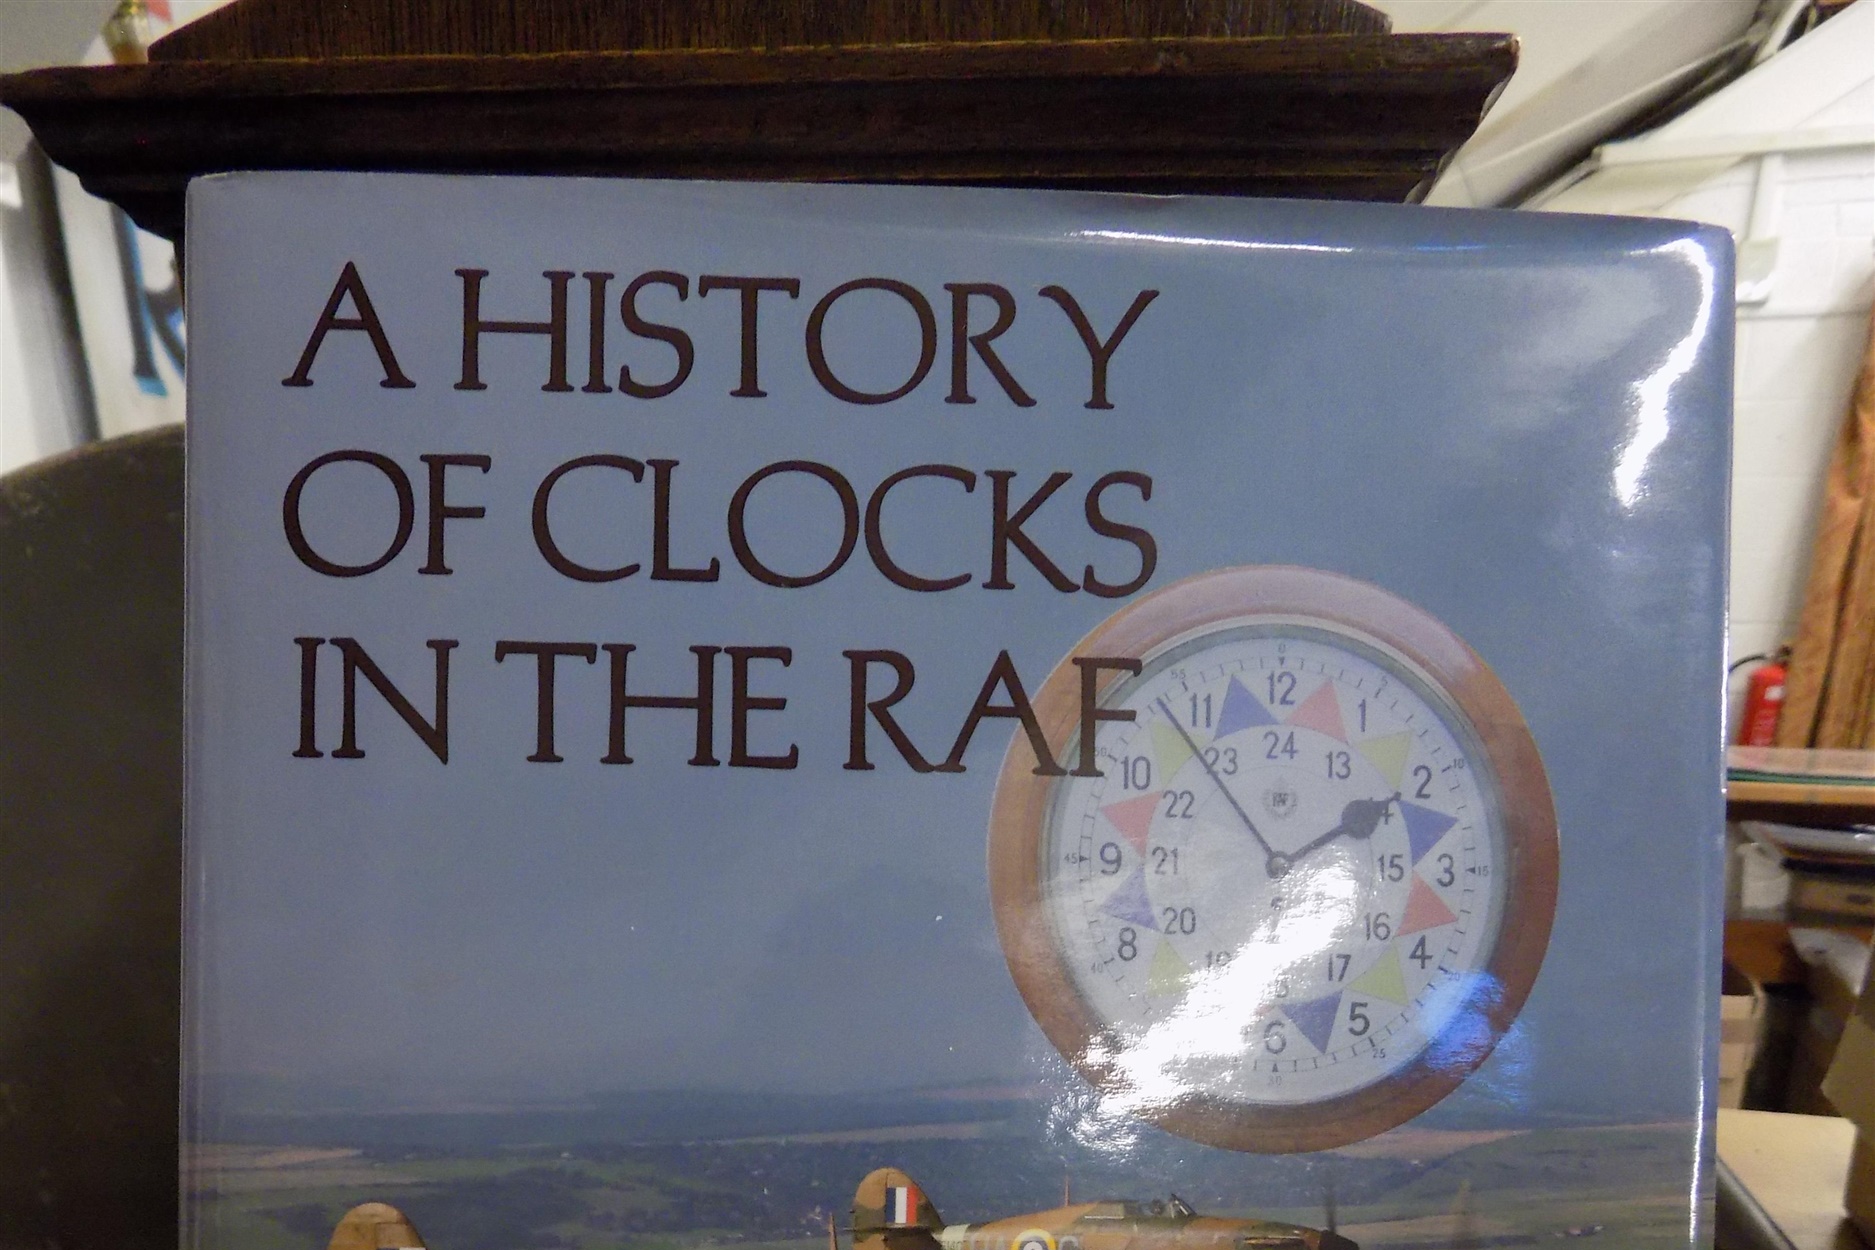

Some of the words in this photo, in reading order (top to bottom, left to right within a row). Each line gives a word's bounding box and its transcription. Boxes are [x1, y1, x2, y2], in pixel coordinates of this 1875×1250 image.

[282, 261, 416, 389] A
[454, 269, 1160, 410] HISTORY
[283, 450, 491, 578] OF
[532, 455, 1158, 599] CLOCKS
[1171, 667, 1187, 680] 55
[1267, 670, 1297, 705] 12
[292, 637, 460, 766] IN
[495, 641, 799, 770] THE
[842, 650, 1142, 778] RAF
[1190, 692, 1212, 728] 11
[1358, 698, 1367, 732] 1
[1205, 746, 1239, 776] 23
[1264, 730, 1298, 760] 24
[1121, 755, 1151, 790] 10
[1326, 750, 1351, 779] 13
[1451, 757, 1466, 769] 10
[1412, 765, 1433, 799] 2
[1163, 789, 1195, 819] 22
[1064, 853, 1078, 865] 45
[1100, 842, 1122, 876] 9
[1152, 846, 1179, 875] 21
[1378, 853, 1404, 883] 15
[1436, 853, 1456, 887] 3
[1477, 865, 1489, 877] 15
[1162, 906, 1196, 935] 20
[1364, 911, 1391, 941] 16
[1118, 926, 1138, 962] 8
[1408, 934, 1433, 970] 4
[1327, 952, 1352, 983] 17
[1348, 1002, 1370, 1036] 5
[1264, 1019, 1287, 1055] 6
[1373, 1048, 1386, 1059] 25
